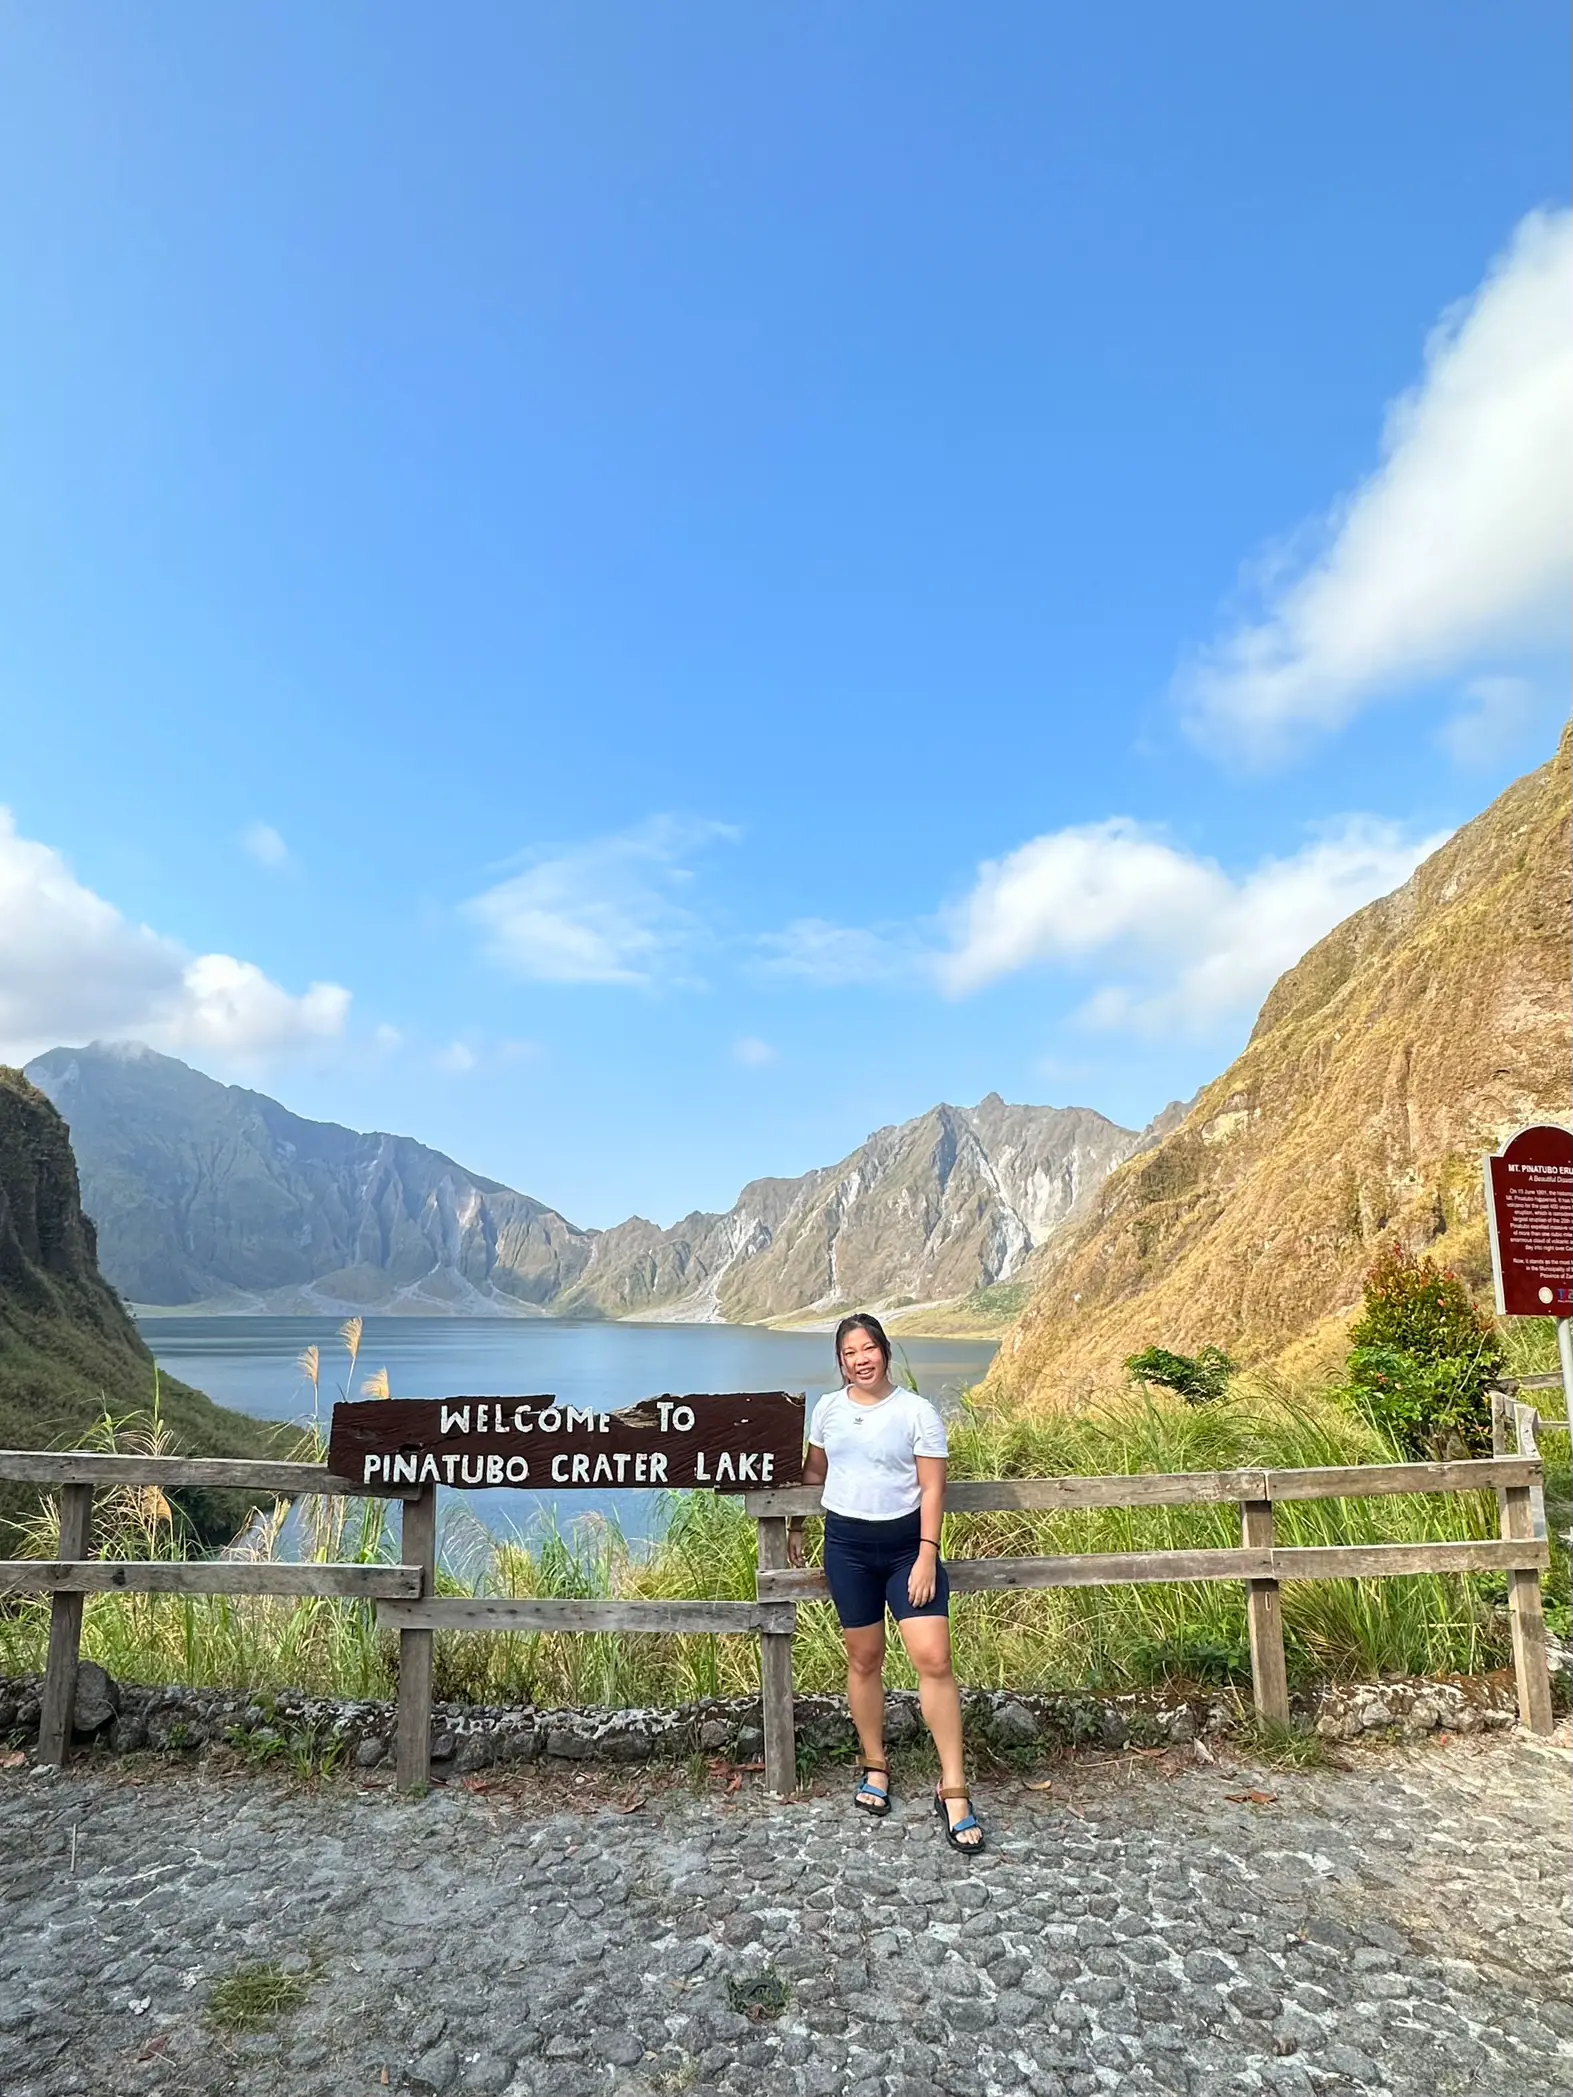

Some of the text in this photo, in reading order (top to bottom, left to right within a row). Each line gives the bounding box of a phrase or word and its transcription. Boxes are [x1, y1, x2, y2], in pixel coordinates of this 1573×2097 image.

[1522, 1165, 1558, 1174] PINATUBO
[440, 1401, 696, 1435] WELCOME TO
[363, 1452, 775, 1484] PINATUBO CRATER LAKE
